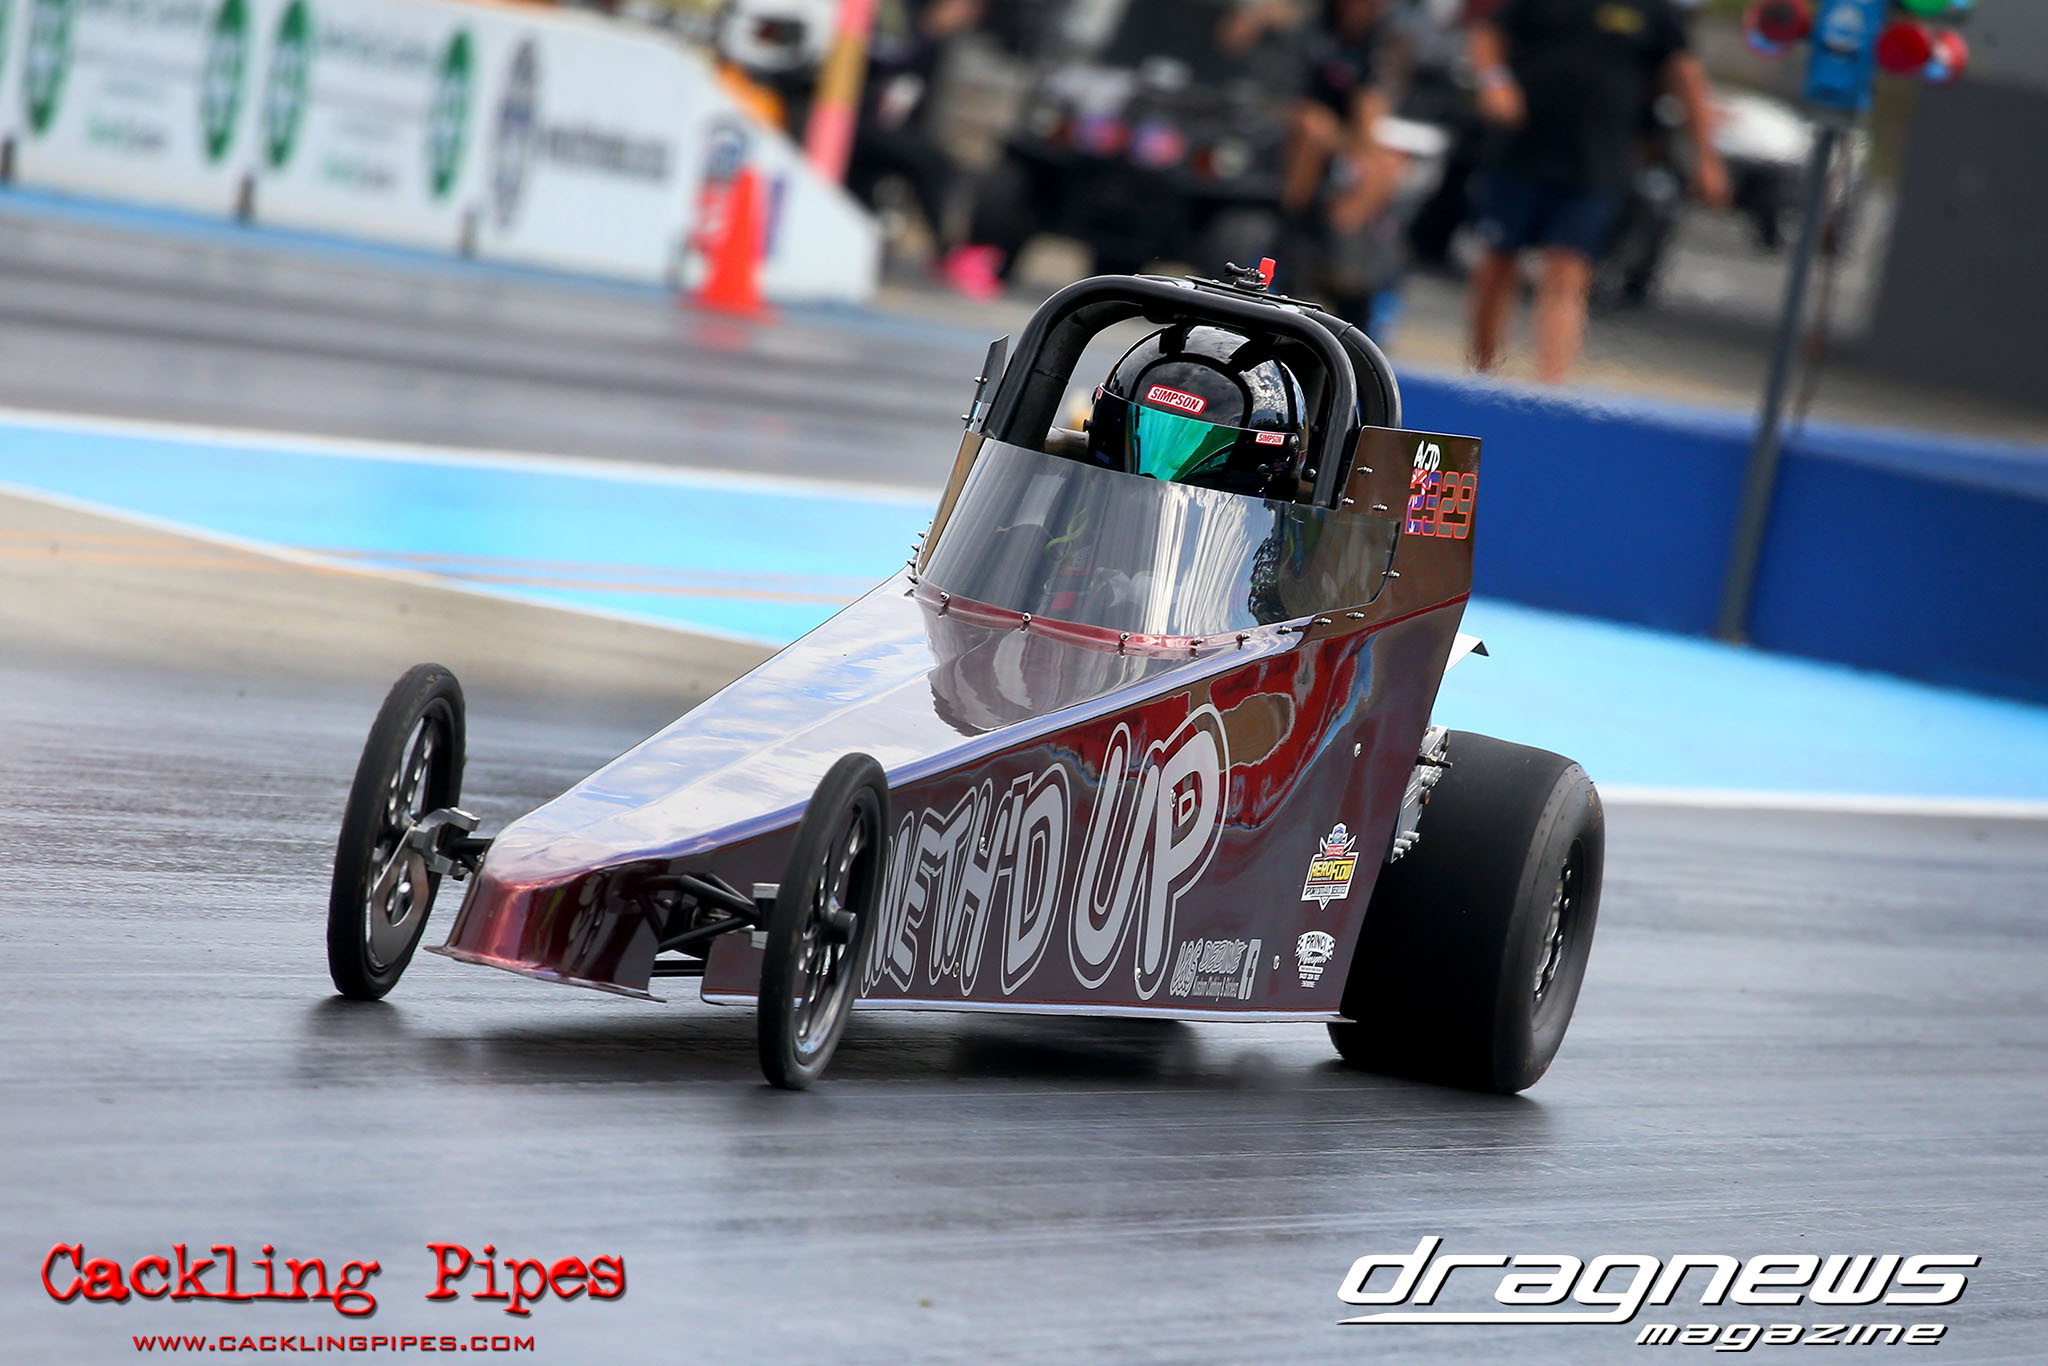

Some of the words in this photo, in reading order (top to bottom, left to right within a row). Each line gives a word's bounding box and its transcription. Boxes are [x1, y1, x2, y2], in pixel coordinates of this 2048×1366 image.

[1150, 387, 1200, 412] SIMPSON
[1258, 434, 1283, 444] SIMPSON
[1404, 468, 1478, 539] 2329
[1068, 703, 1230, 1000] UP
[1308, 860, 1354, 882] AEROFLOW
